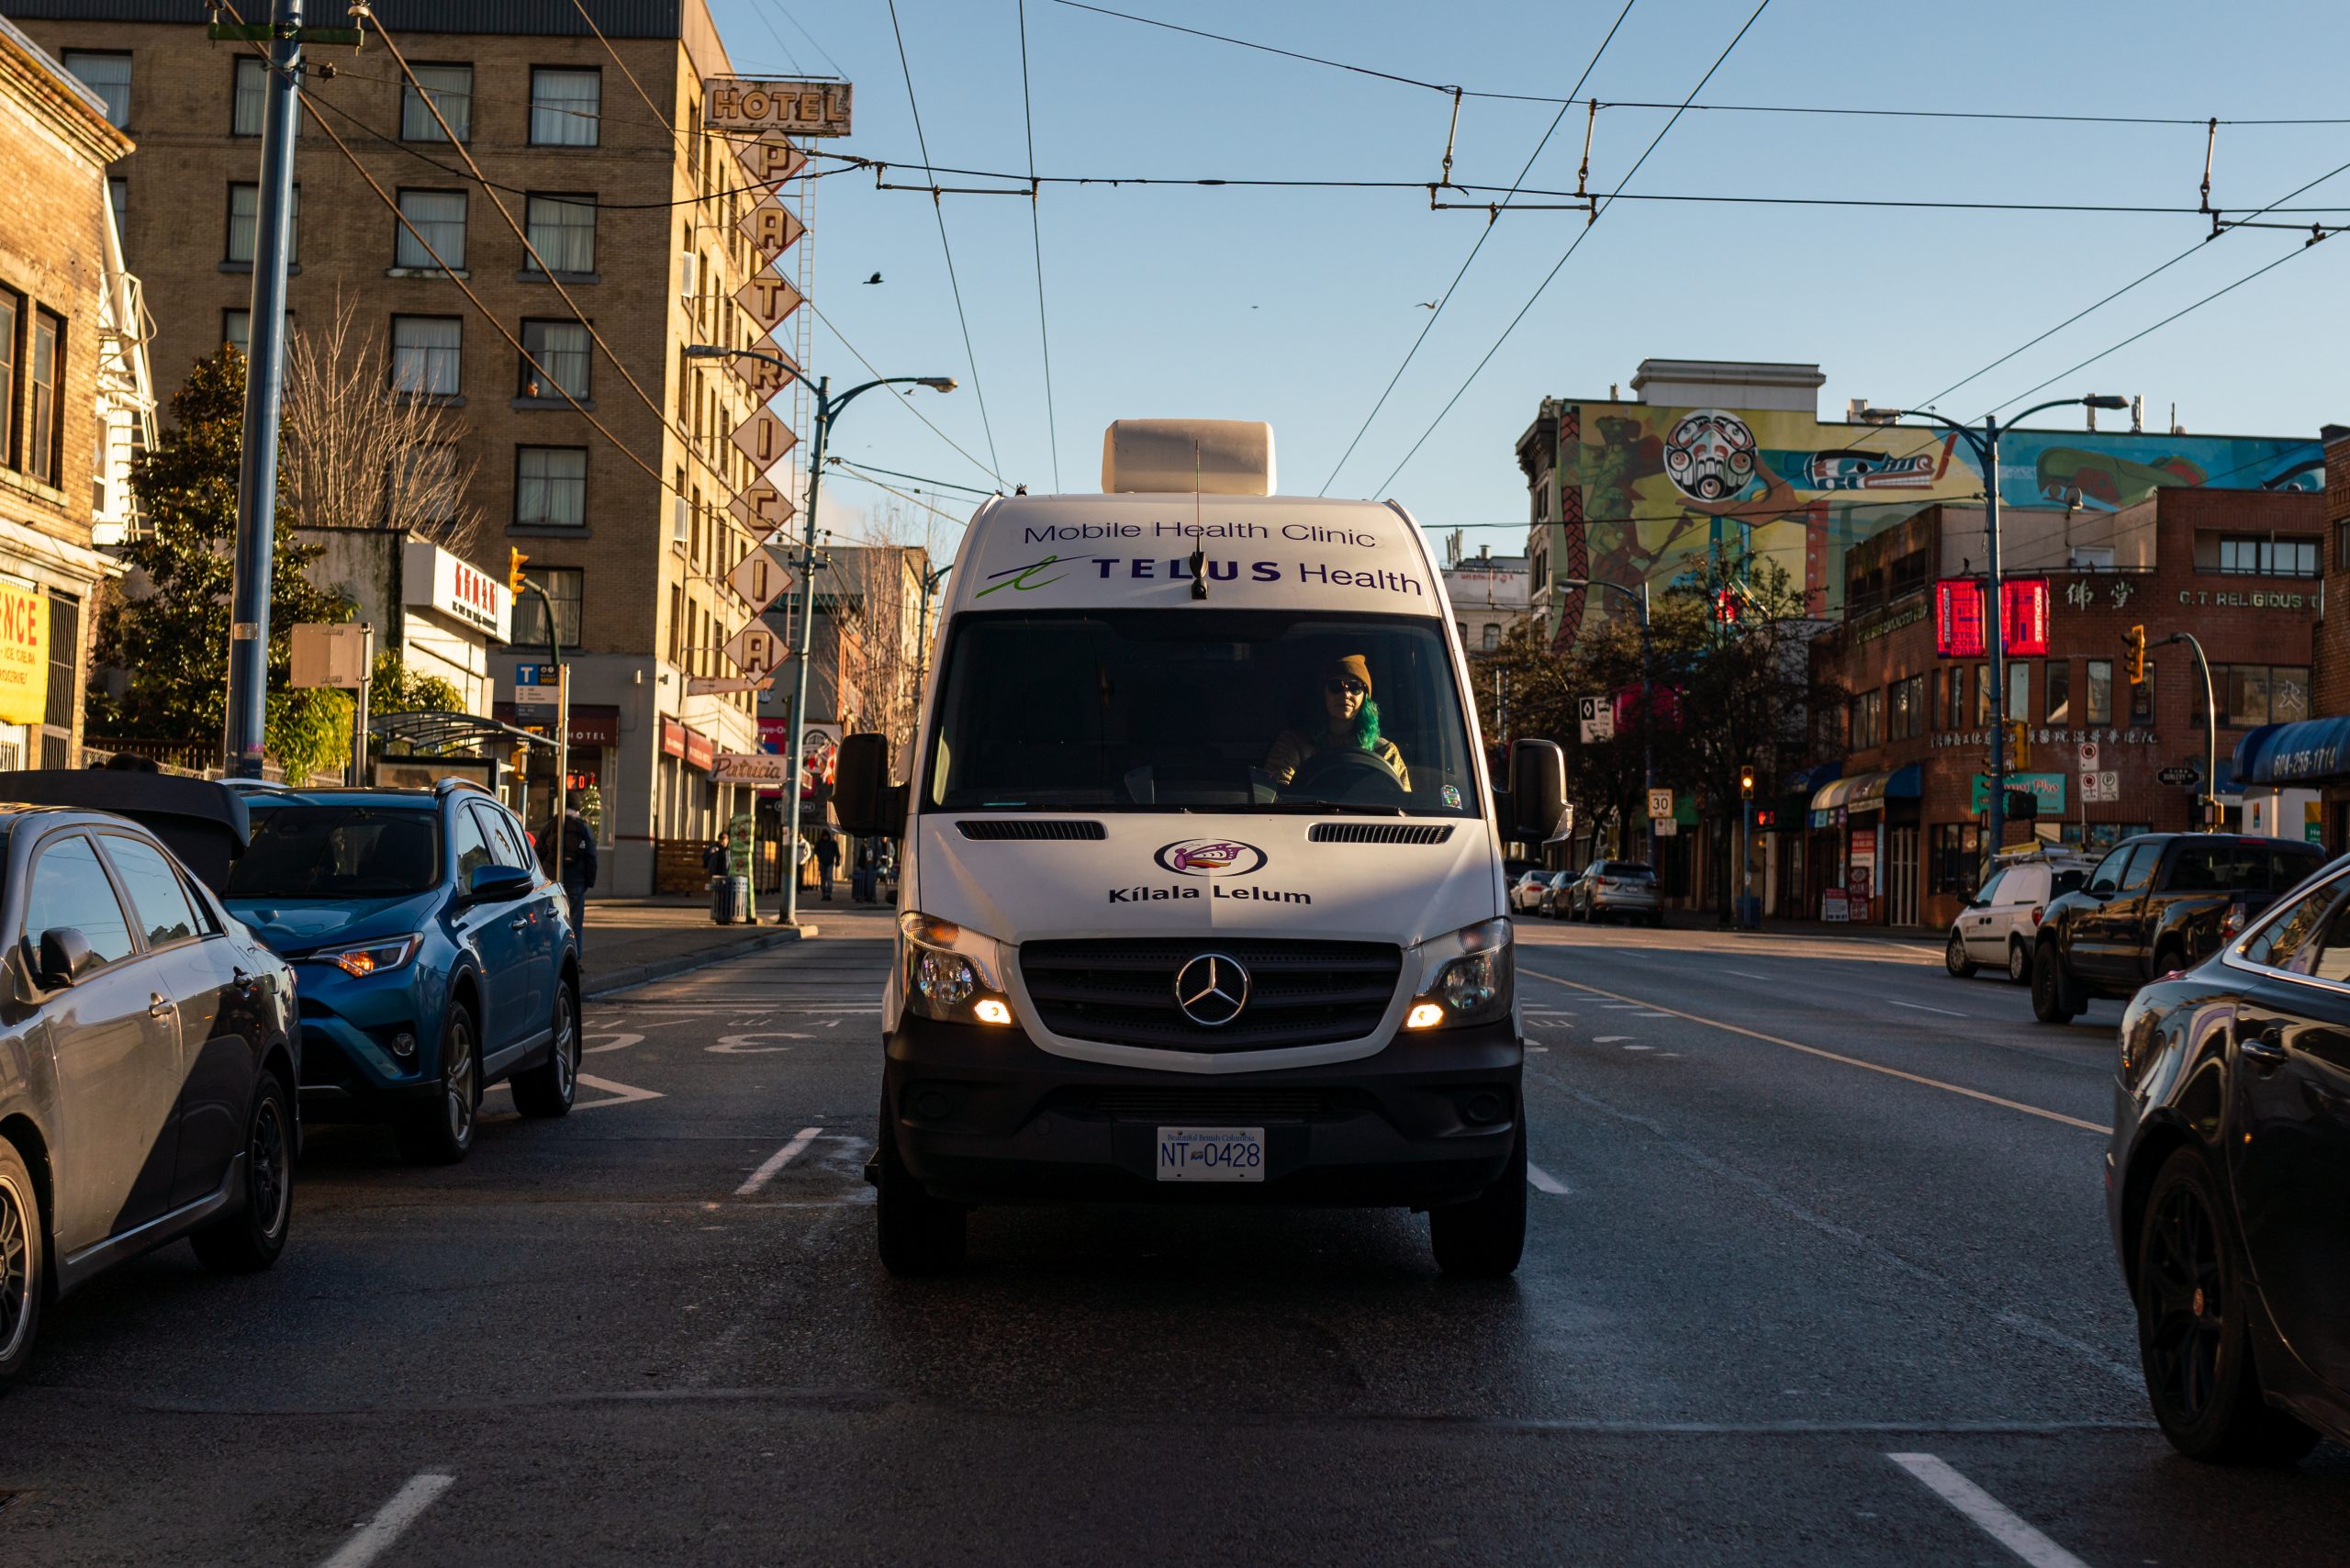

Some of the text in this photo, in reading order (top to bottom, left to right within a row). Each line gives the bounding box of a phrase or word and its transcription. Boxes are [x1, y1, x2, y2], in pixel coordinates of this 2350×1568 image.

[712, 89, 845, 122] HOTEL
[1024, 521, 1377, 549] Mobile Health Clinic
[1092, 558, 1423, 596] TELUS Health
[2216, 592, 2303, 608] RELIGIOUS
[0, 590, 37, 646] NCE
[711, 757, 781, 779] Patricia
[2273, 746, 2336, 777] 604-255-1714
[1653, 798, 1669, 810] 30
[1109, 884, 1312, 905] Kílala Lelum
[1168, 1133, 1255, 1142] Beautiful British Columbia
[1161, 1142, 1260, 1168] NT 0428
